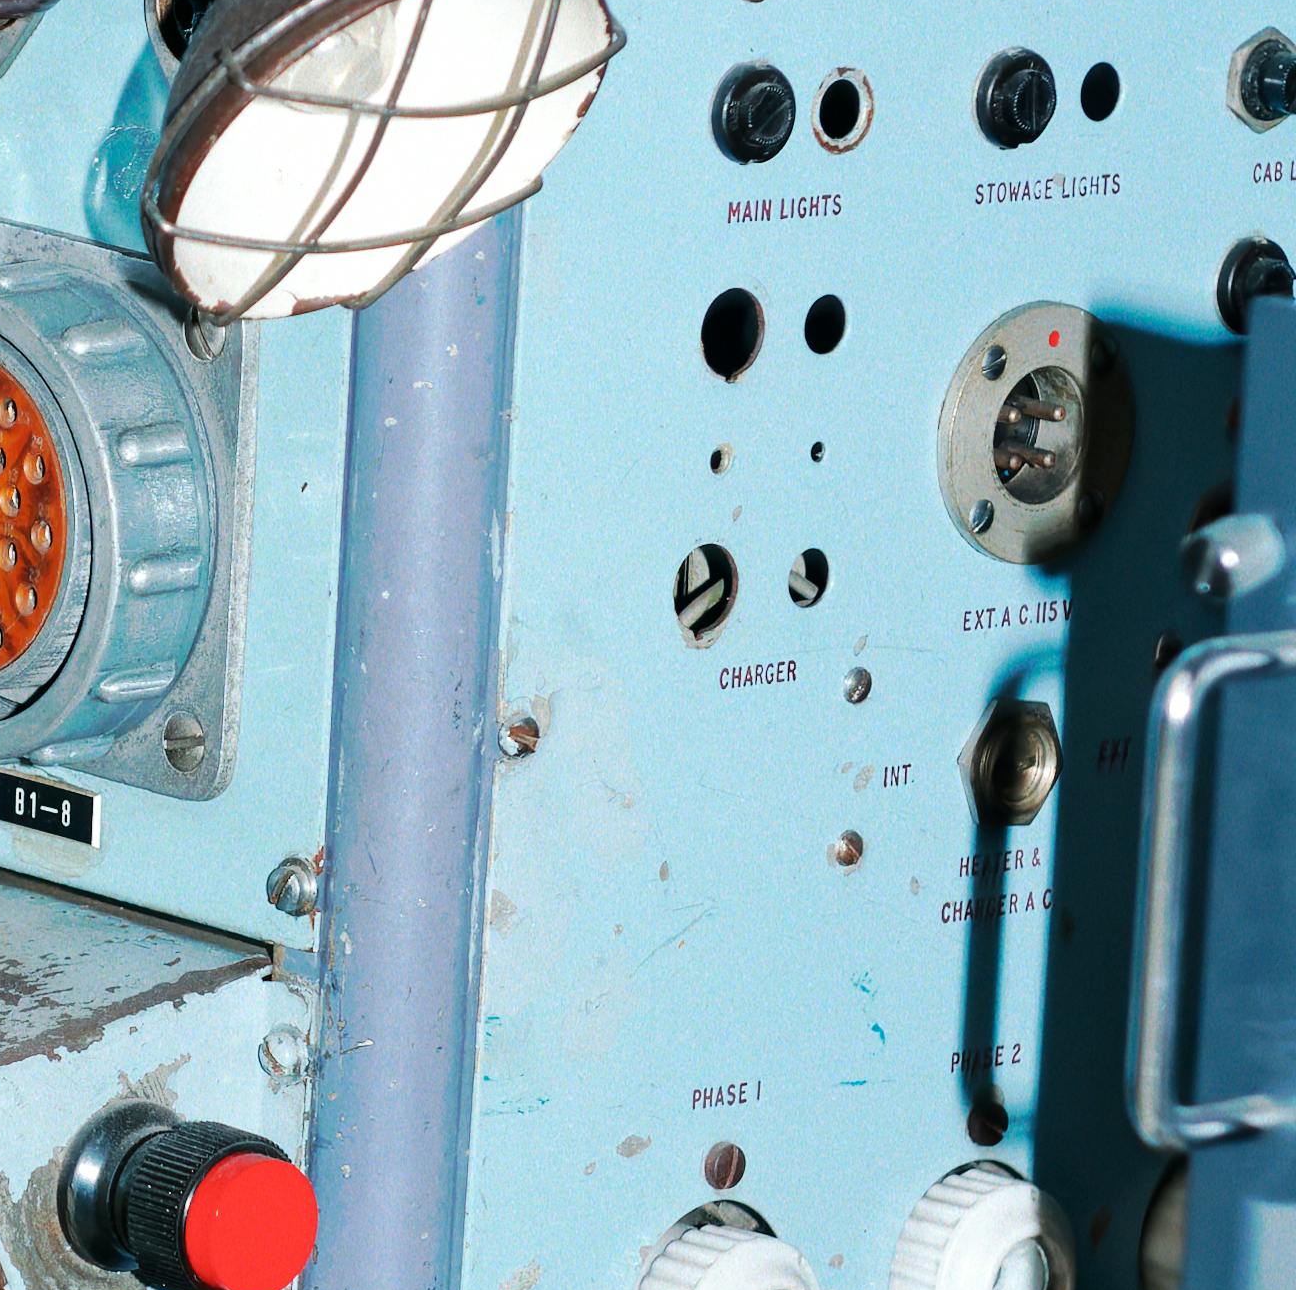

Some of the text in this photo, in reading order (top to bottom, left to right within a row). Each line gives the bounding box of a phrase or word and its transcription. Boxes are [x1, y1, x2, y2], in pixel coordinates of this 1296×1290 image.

[1253, 161, 1283, 184] CAB
[975, 173, 1121, 205] STOWAGE LIGHTS
[727, 194, 842, 224] MAIN LIGHTS
[719, 660, 797, 690] CHARGER
[883, 763, 915, 788] INT.
[15, 787, 71, 828] B1-8
[1032, 847, 1041, 868] &
[951, 1043, 1022, 1074] PHASE 2
[692, 1080, 762, 1110] PHASE 1
